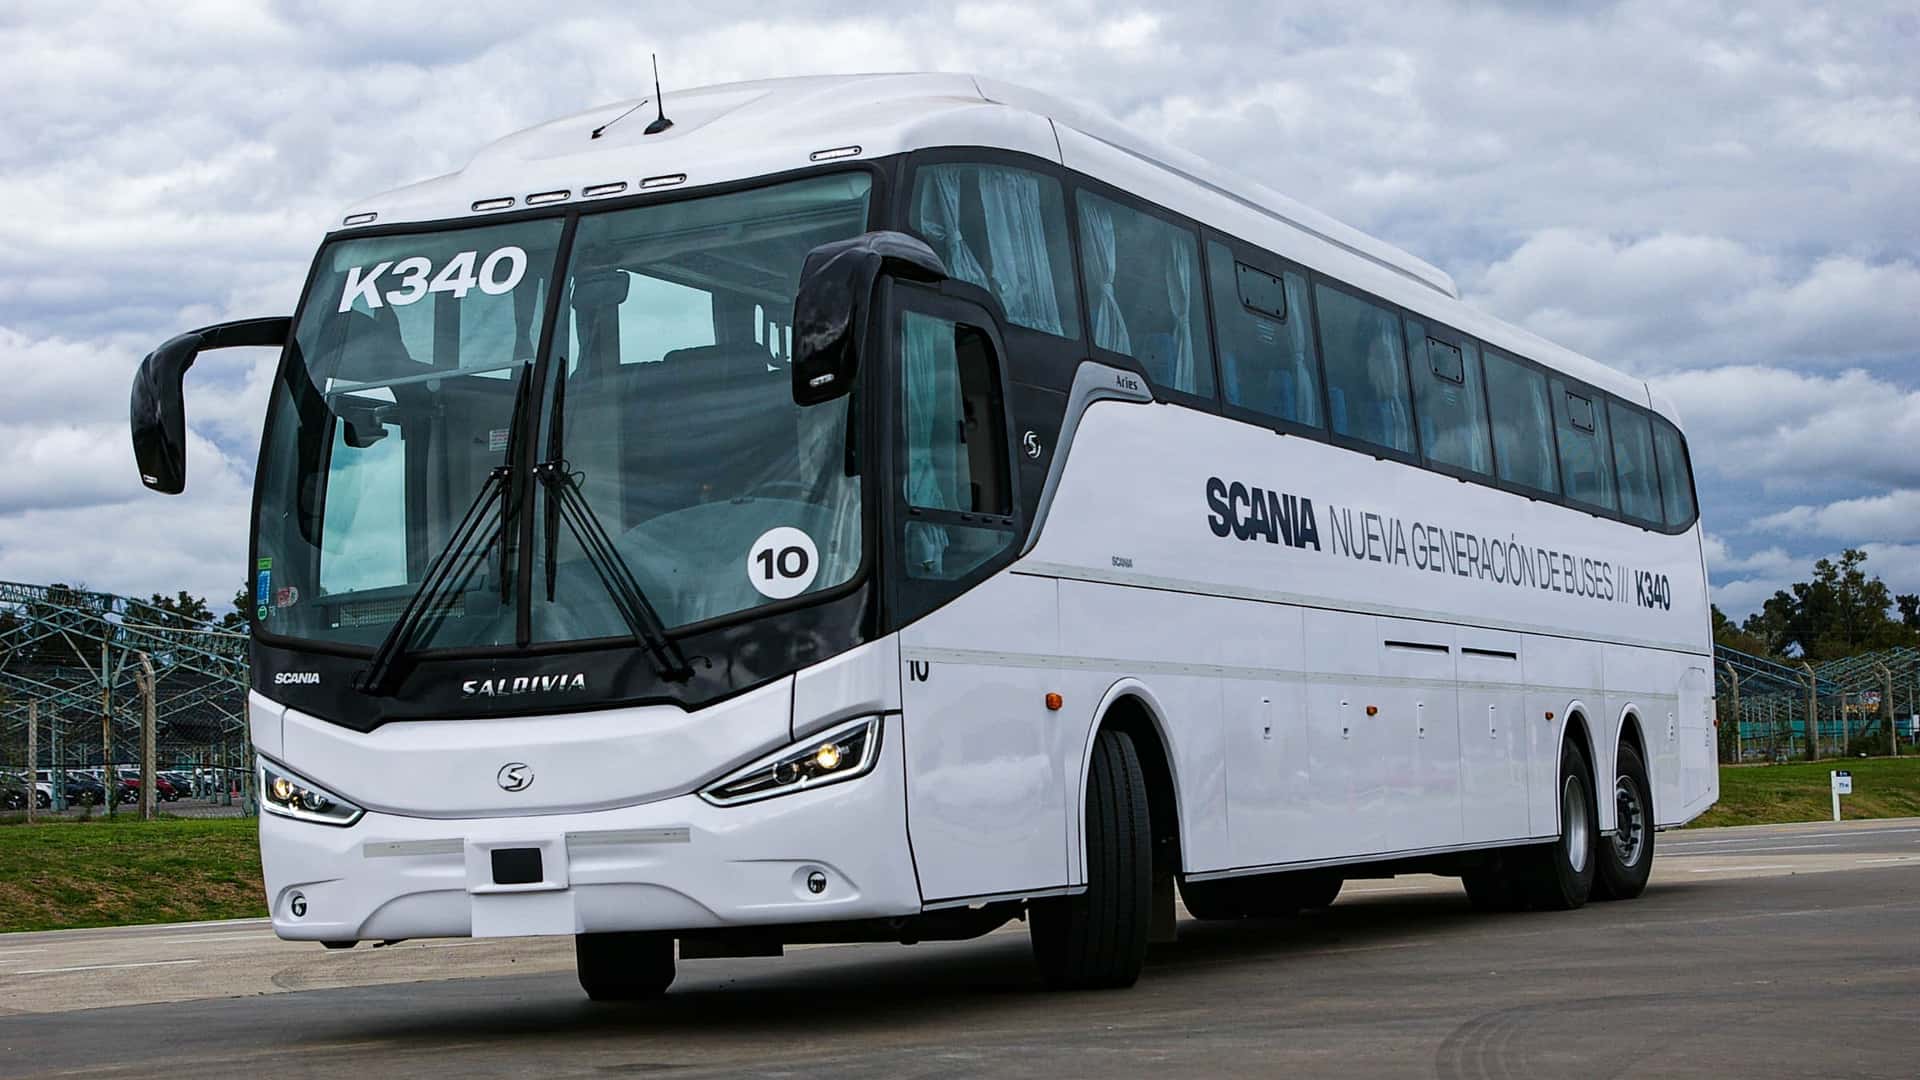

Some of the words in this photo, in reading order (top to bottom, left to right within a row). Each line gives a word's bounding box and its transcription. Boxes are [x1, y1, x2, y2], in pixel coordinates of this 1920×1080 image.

[338, 246, 527, 313] K340
[1115, 375, 1138, 391] Aries
[1206, 477, 1321, 552] SCANIA
[1329, 505, 1410, 567] NUEVA
[1411, 522, 1536, 588] GENERACIÓN
[1537, 548, 1561, 592] DE
[1562, 553, 1614, 602] BUSES
[1635, 569, 1671, 611] K340
[757, 546, 809, 580] 10
[1111, 556, 1133, 568] SCANIA
[274, 672, 320, 685] SCANIA
[461, 673, 586, 697] SALDIVIA
